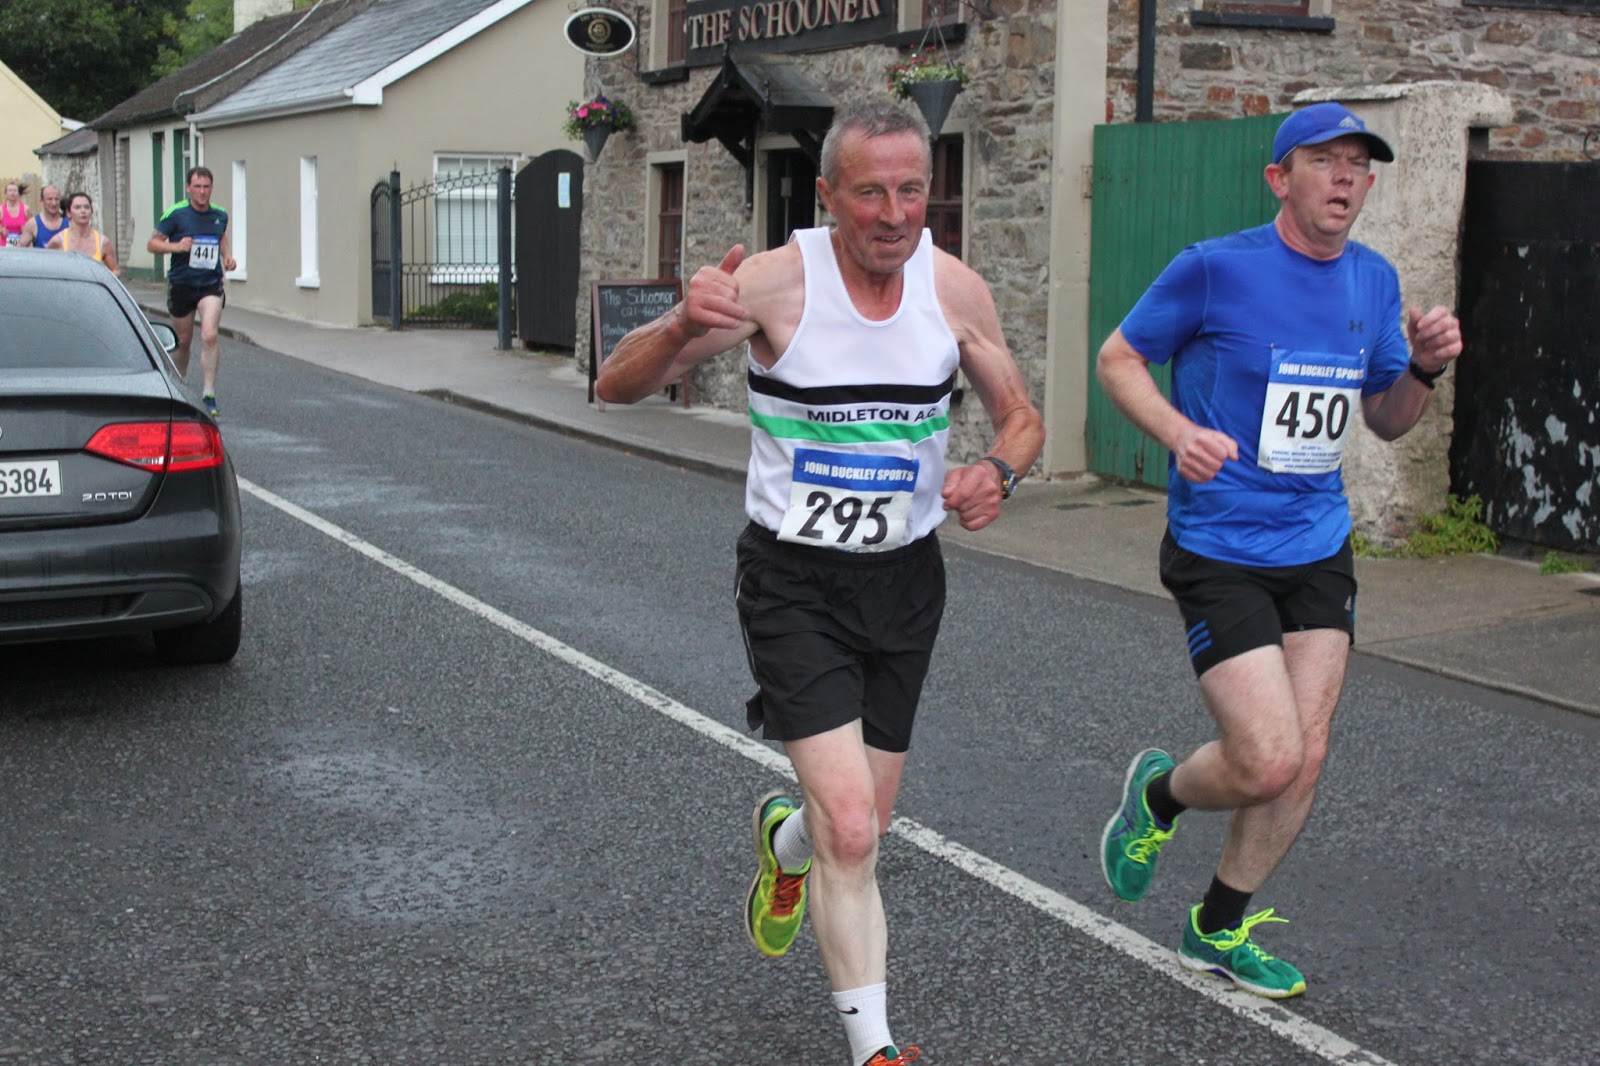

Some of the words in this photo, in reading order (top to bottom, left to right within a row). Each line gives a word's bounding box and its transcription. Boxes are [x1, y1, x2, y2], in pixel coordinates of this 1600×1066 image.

[688, 9, 732, 49] THE
[194, 246, 214, 260] 441
[601, 289, 622, 306] The
[1278, 363, 1300, 376] JOHN
[1300, 365, 1336, 378] BUCKLEY
[807, 408, 909, 423] MIDLETON
[1275, 391, 1350, 440] 450
[804, 461, 830, 476] JOHN
[831, 465, 877, 481] BUCKLEY
[876, 468, 915, 482] SPORTS
[796, 491, 892, 545] 295
